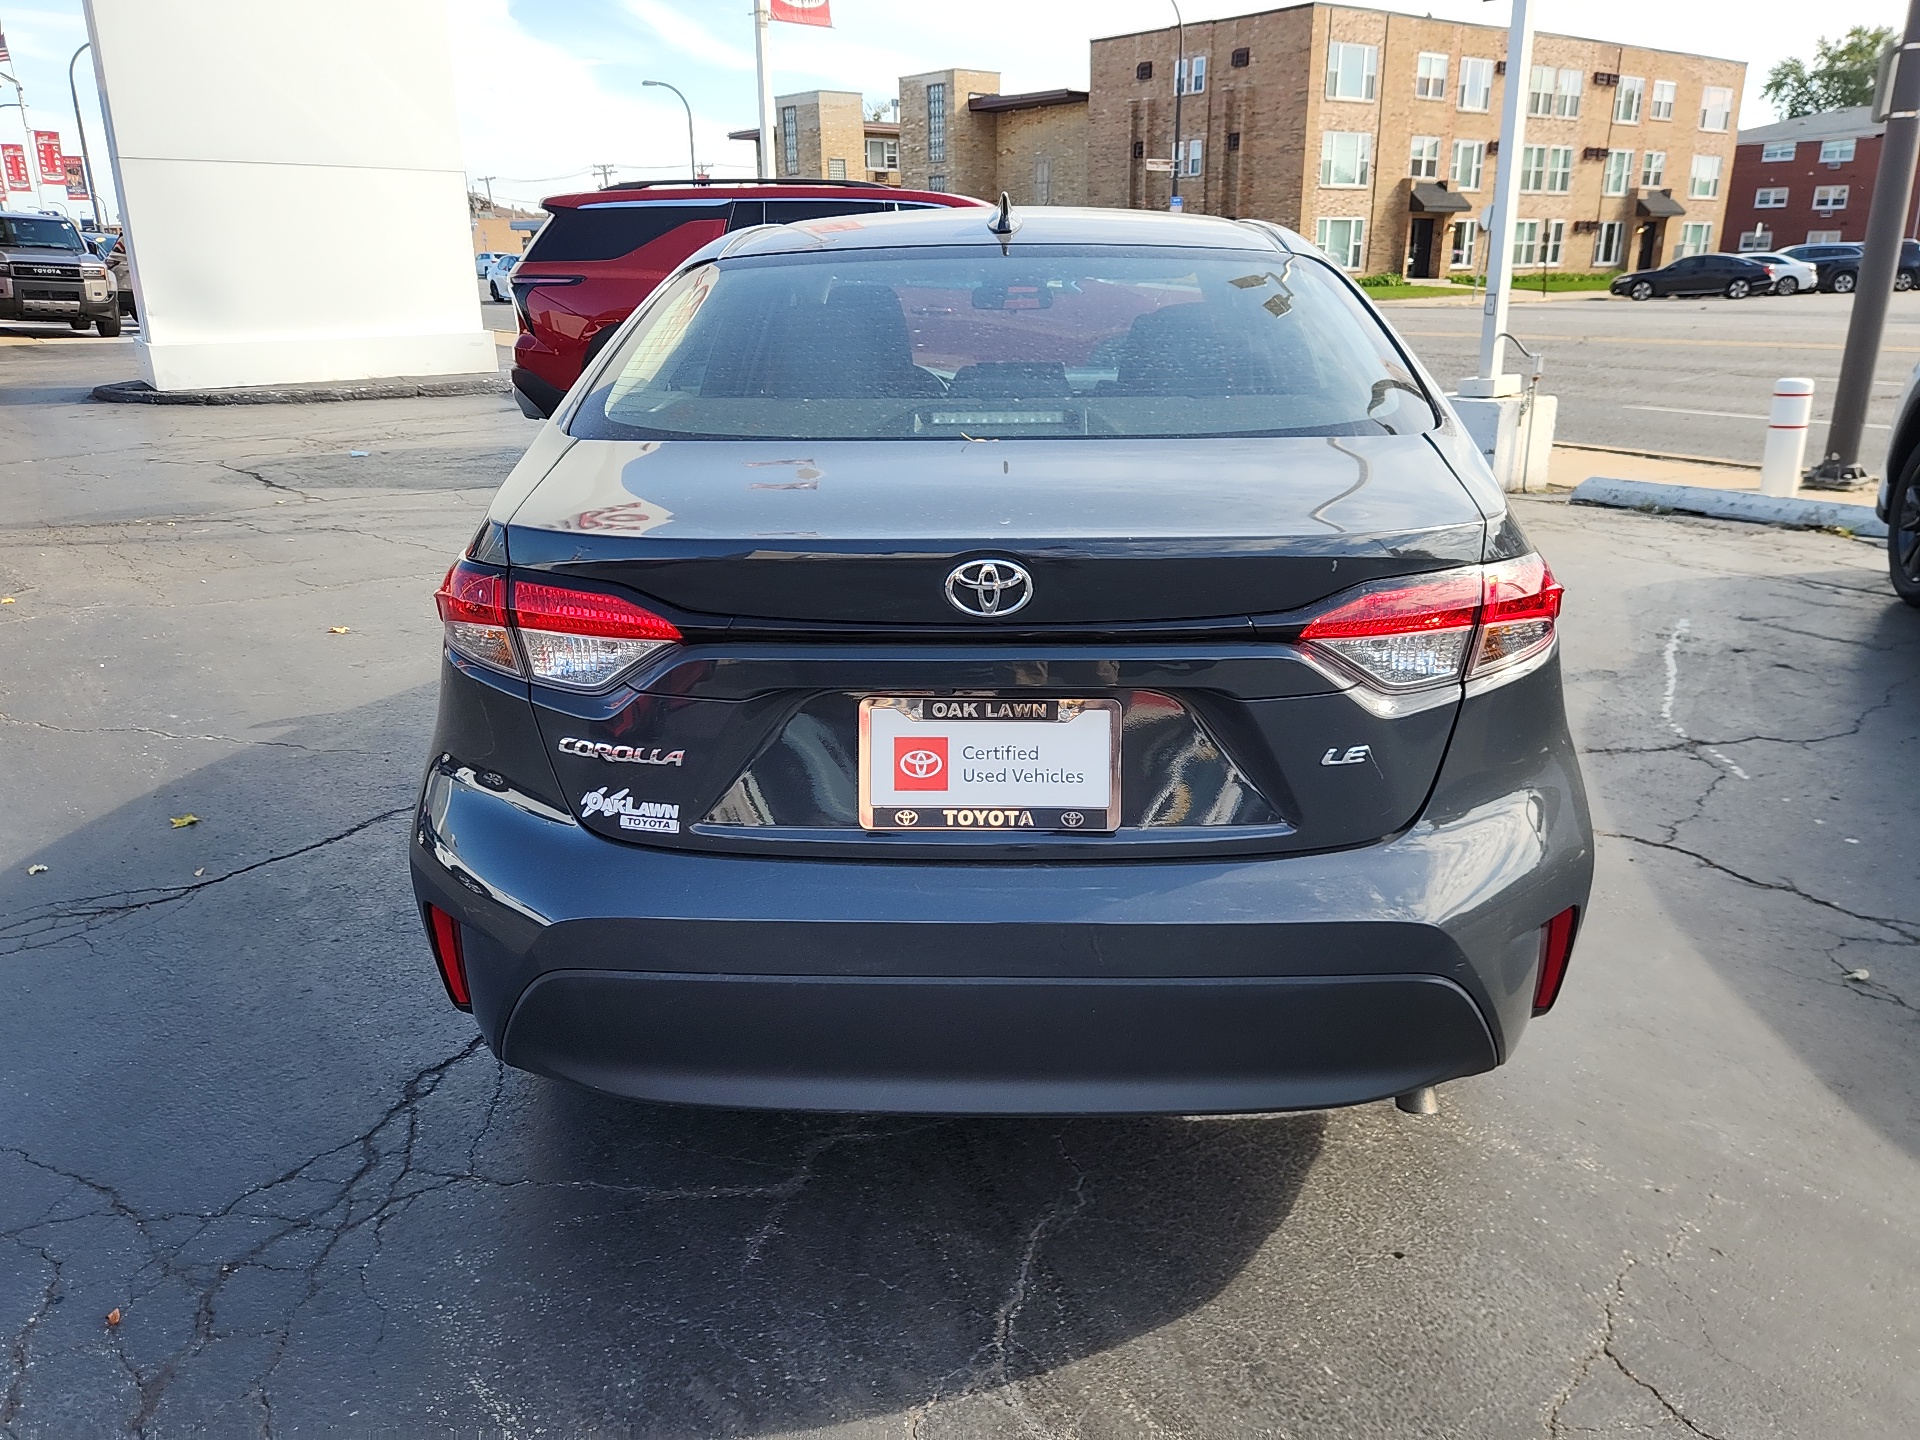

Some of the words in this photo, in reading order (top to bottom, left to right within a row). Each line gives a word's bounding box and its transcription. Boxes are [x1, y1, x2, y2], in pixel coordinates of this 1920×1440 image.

[38, 145, 49, 172] USED
[53, 146, 62, 173] CARS
[932, 702, 979, 718] OAK
[985, 703, 1047, 718] LAWN
[558, 737, 686, 767] COROLLA
[962, 745, 1039, 761] Certified
[1321, 745, 1370, 766] LE
[962, 768, 1007, 783] Used
[1012, 768, 1084, 784] Vehicles
[627, 817, 671, 829] TOYOTA
[943, 809, 1034, 827] TOYOTA
